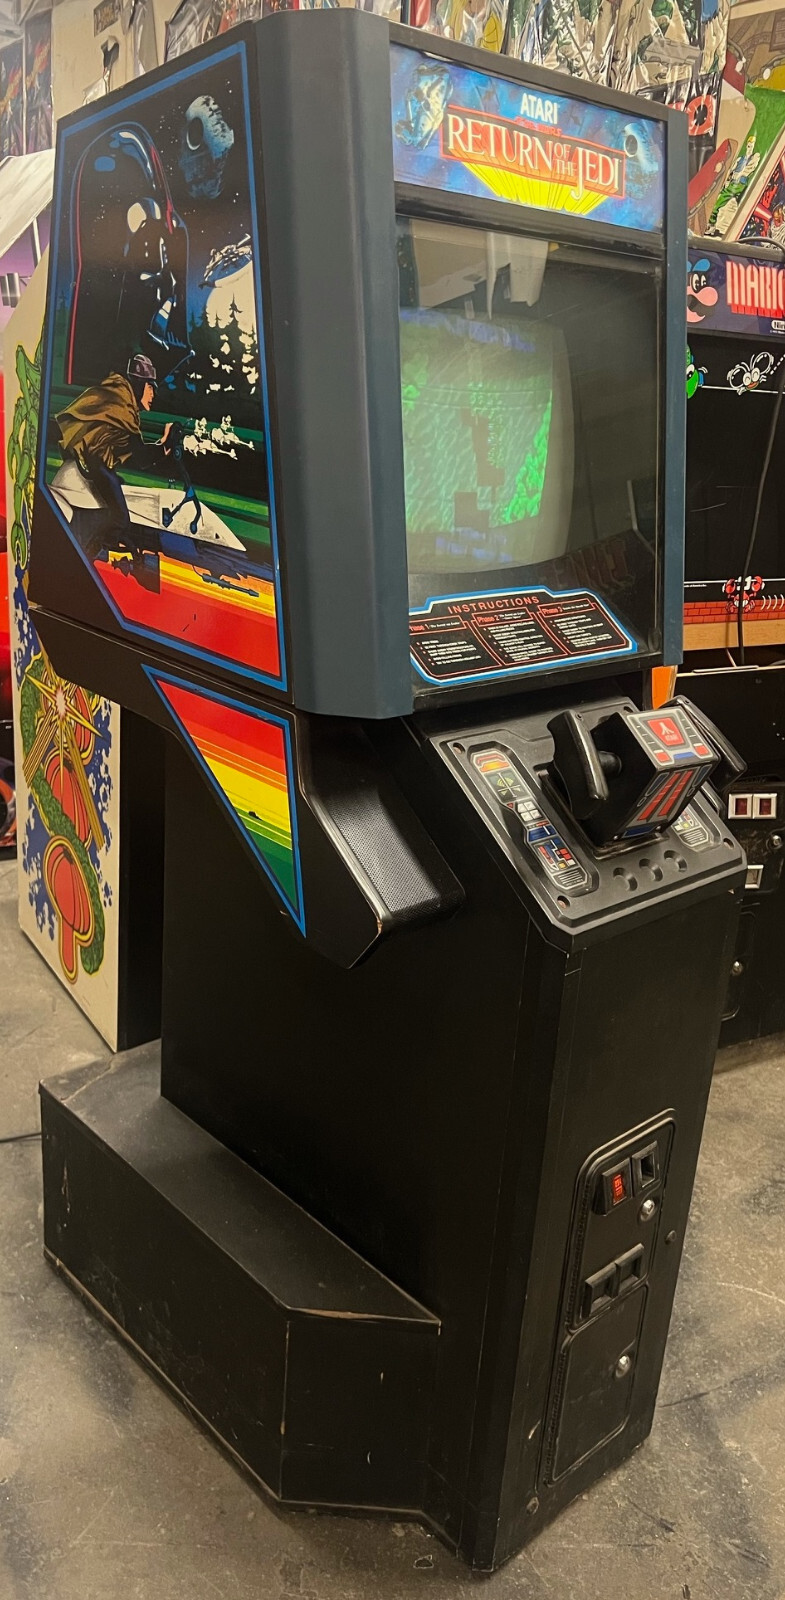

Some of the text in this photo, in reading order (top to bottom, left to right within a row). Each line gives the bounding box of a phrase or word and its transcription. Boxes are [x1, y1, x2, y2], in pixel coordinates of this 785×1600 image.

[520, 92, 558, 125] ATARI
[447, 113, 553, 172] RETURN
[553, 142, 571, 161] OF
[554, 158, 577, 177] THE
[571, 146, 620, 200] JEDI
[447, 596, 540, 614] INSTRUCTIONS
